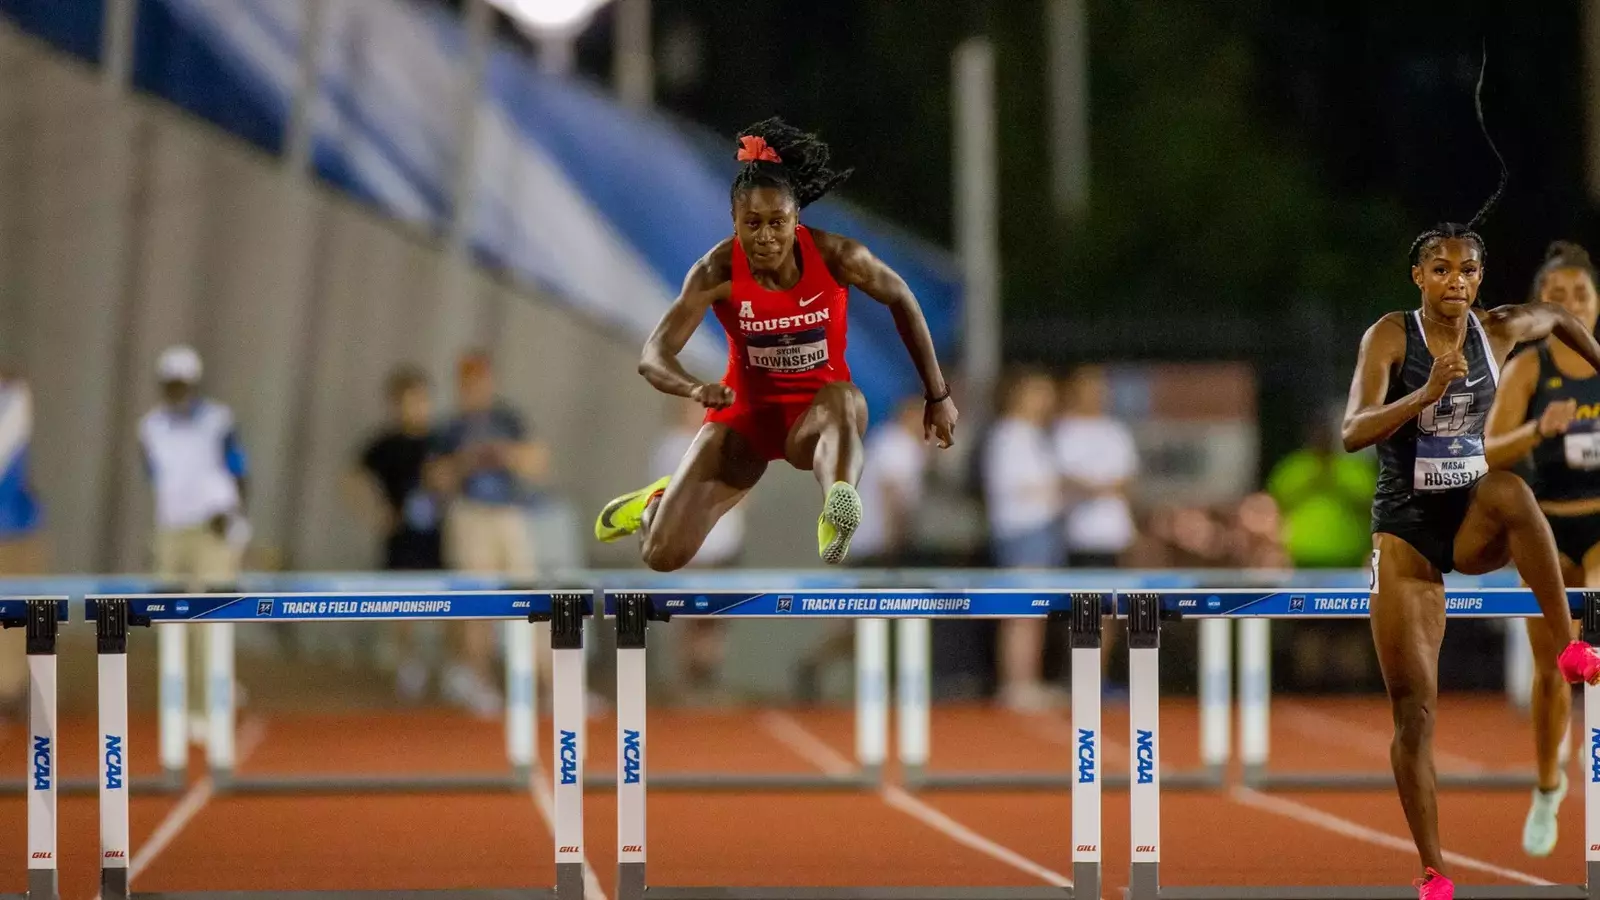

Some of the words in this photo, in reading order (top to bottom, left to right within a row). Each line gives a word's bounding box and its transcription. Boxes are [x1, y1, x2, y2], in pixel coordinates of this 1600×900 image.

[739, 308, 830, 332] HOUSTON
[753, 349, 825, 367] TOWNSEND
[1441, 461, 1466, 470] MASAI
[282, 601, 318, 614] TRACK
[318, 601, 328, 614] &
[328, 601, 359, 614] FIELD
[360, 600, 452, 613] CHAMPIONSHIPS
[801, 598, 837, 611] TRACK
[838, 598, 847, 611] &
[847, 598, 877, 611] FIELD
[879, 597, 971, 611] CHAMPIONSHIPS
[1031, 599, 1050, 607] GILL
[1314, 598, 1349, 610] TRACK
[1349, 598, 1359, 610] &
[34, 735, 50, 790] NCAA
[105, 734, 122, 789] NCAA
[560, 729, 576, 784] NCAA
[624, 729, 640, 784] NCAA
[1078, 728, 1094, 784] NCAA
[1137, 729, 1153, 784] NCAA
[1135, 845, 1156, 853] GILL
